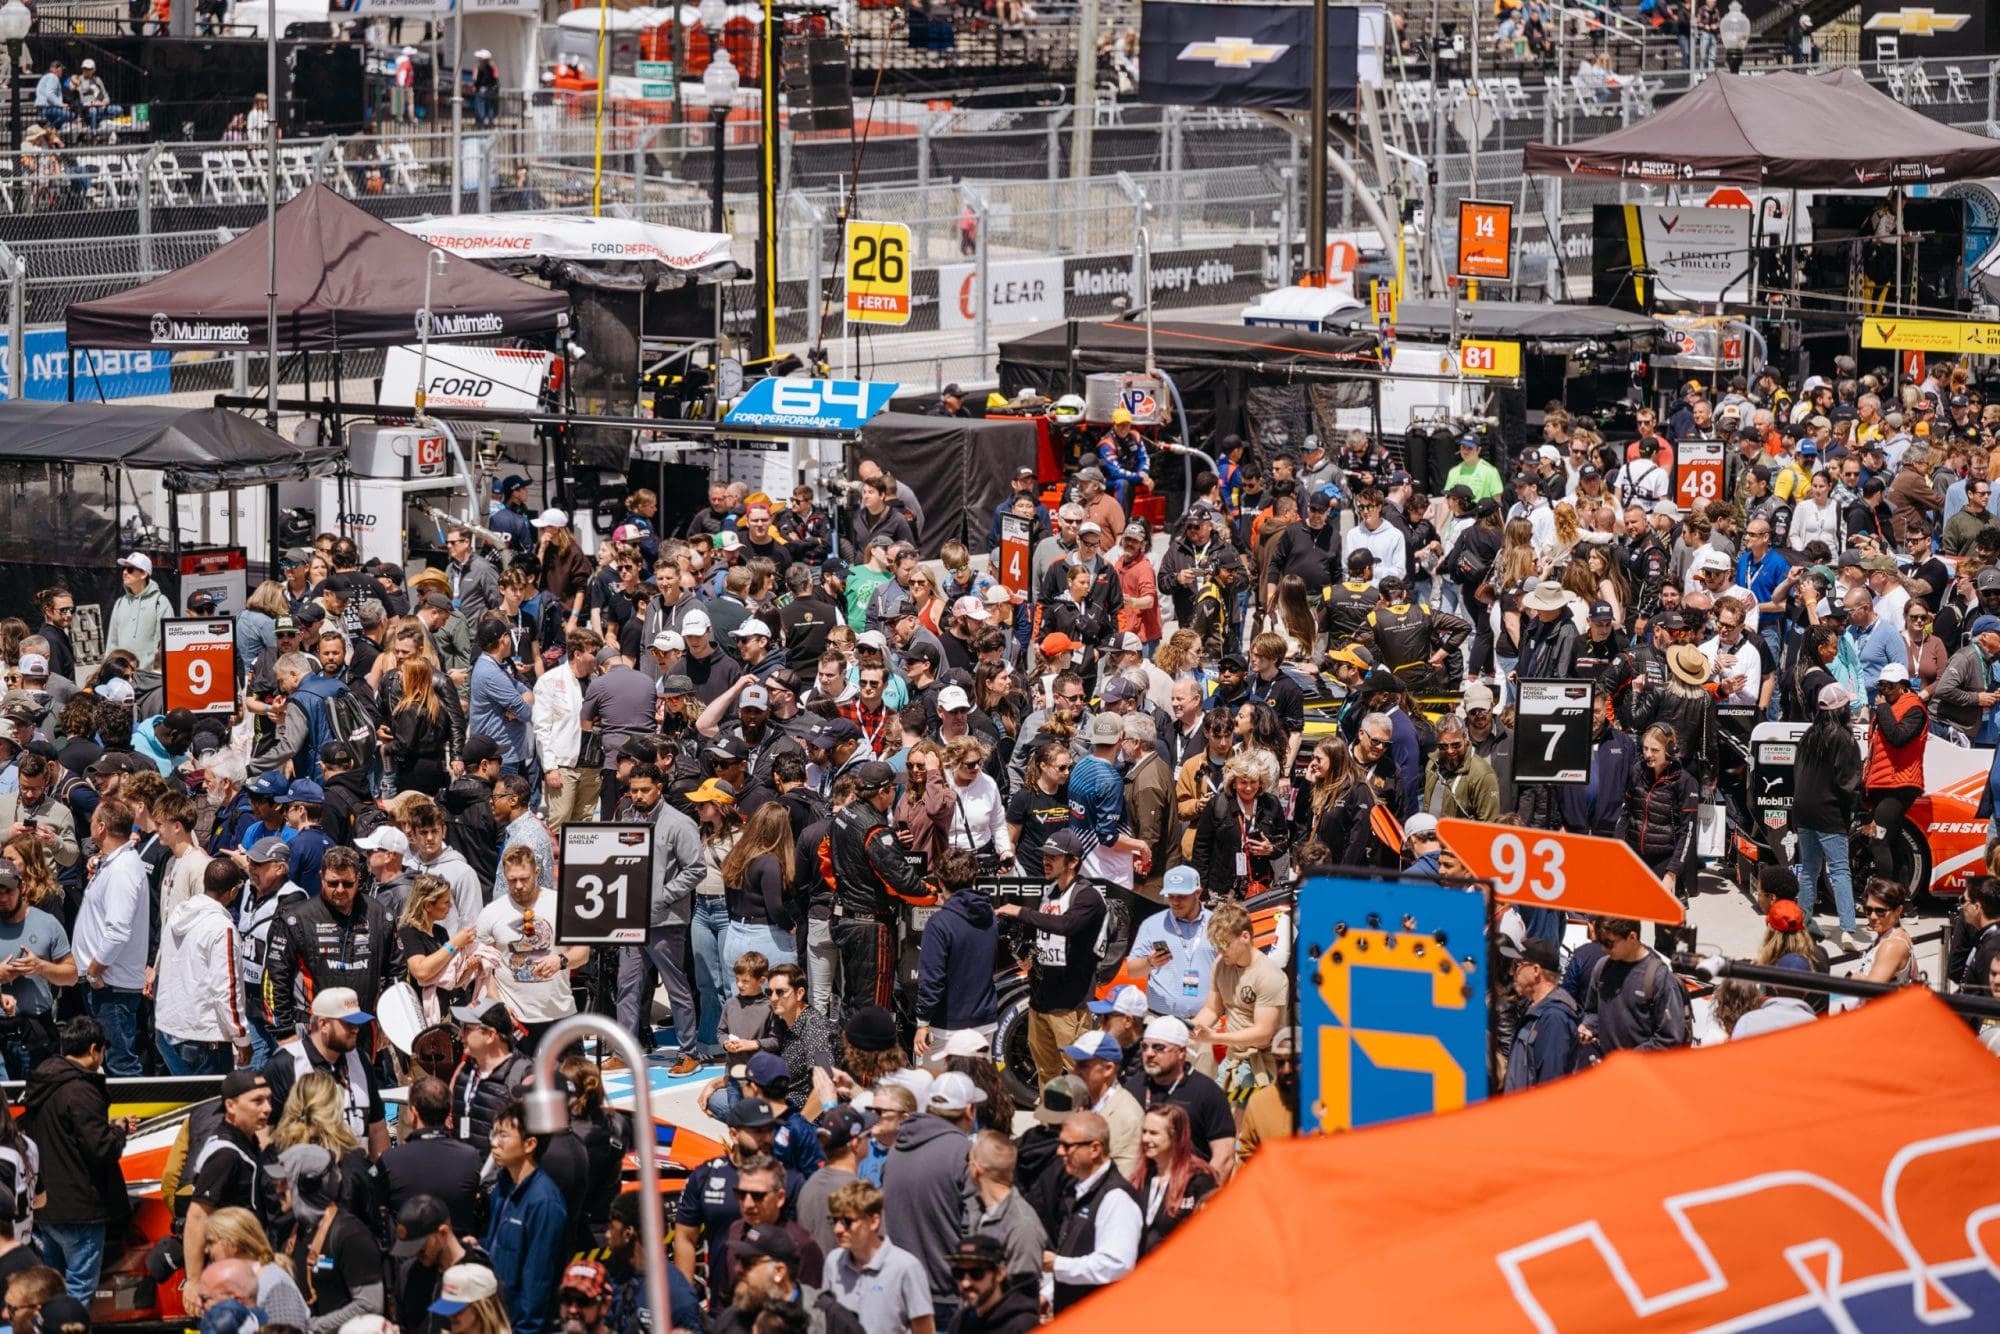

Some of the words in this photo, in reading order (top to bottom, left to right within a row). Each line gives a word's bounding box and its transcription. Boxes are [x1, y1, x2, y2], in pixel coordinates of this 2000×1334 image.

[1475, 214, 1496, 238] 14
[852, 236, 904, 283] 26
[993, 279, 1045, 305] LEAR
[1074, 267, 1136, 297] Making
[857, 295, 898, 311] HERTA
[174, 321, 249, 341] Multimatic
[435, 313, 504, 335] Multimatic
[32, 350, 83, 382] NTT
[1465, 346, 1492, 369] 81
[1908, 354, 1920, 380] 4
[428, 377, 493, 397] FORD
[772, 378, 869, 419] 64
[1122, 390, 1145, 415] VP
[422, 440, 443, 463] 64
[1681, 470, 1717, 498] 48
[1009, 550, 1021, 582] 4
[187, 658, 212, 695] 9
[1541, 724, 1566, 761] 7
[1757, 796, 1783, 806] Mobil
[1766, 809, 1786, 818] TAG
[614, 857, 642, 865] GTP
[1490, 832, 1567, 901] 93
[574, 874, 628, 920] 31
[326, 959, 369, 971] WELEN
